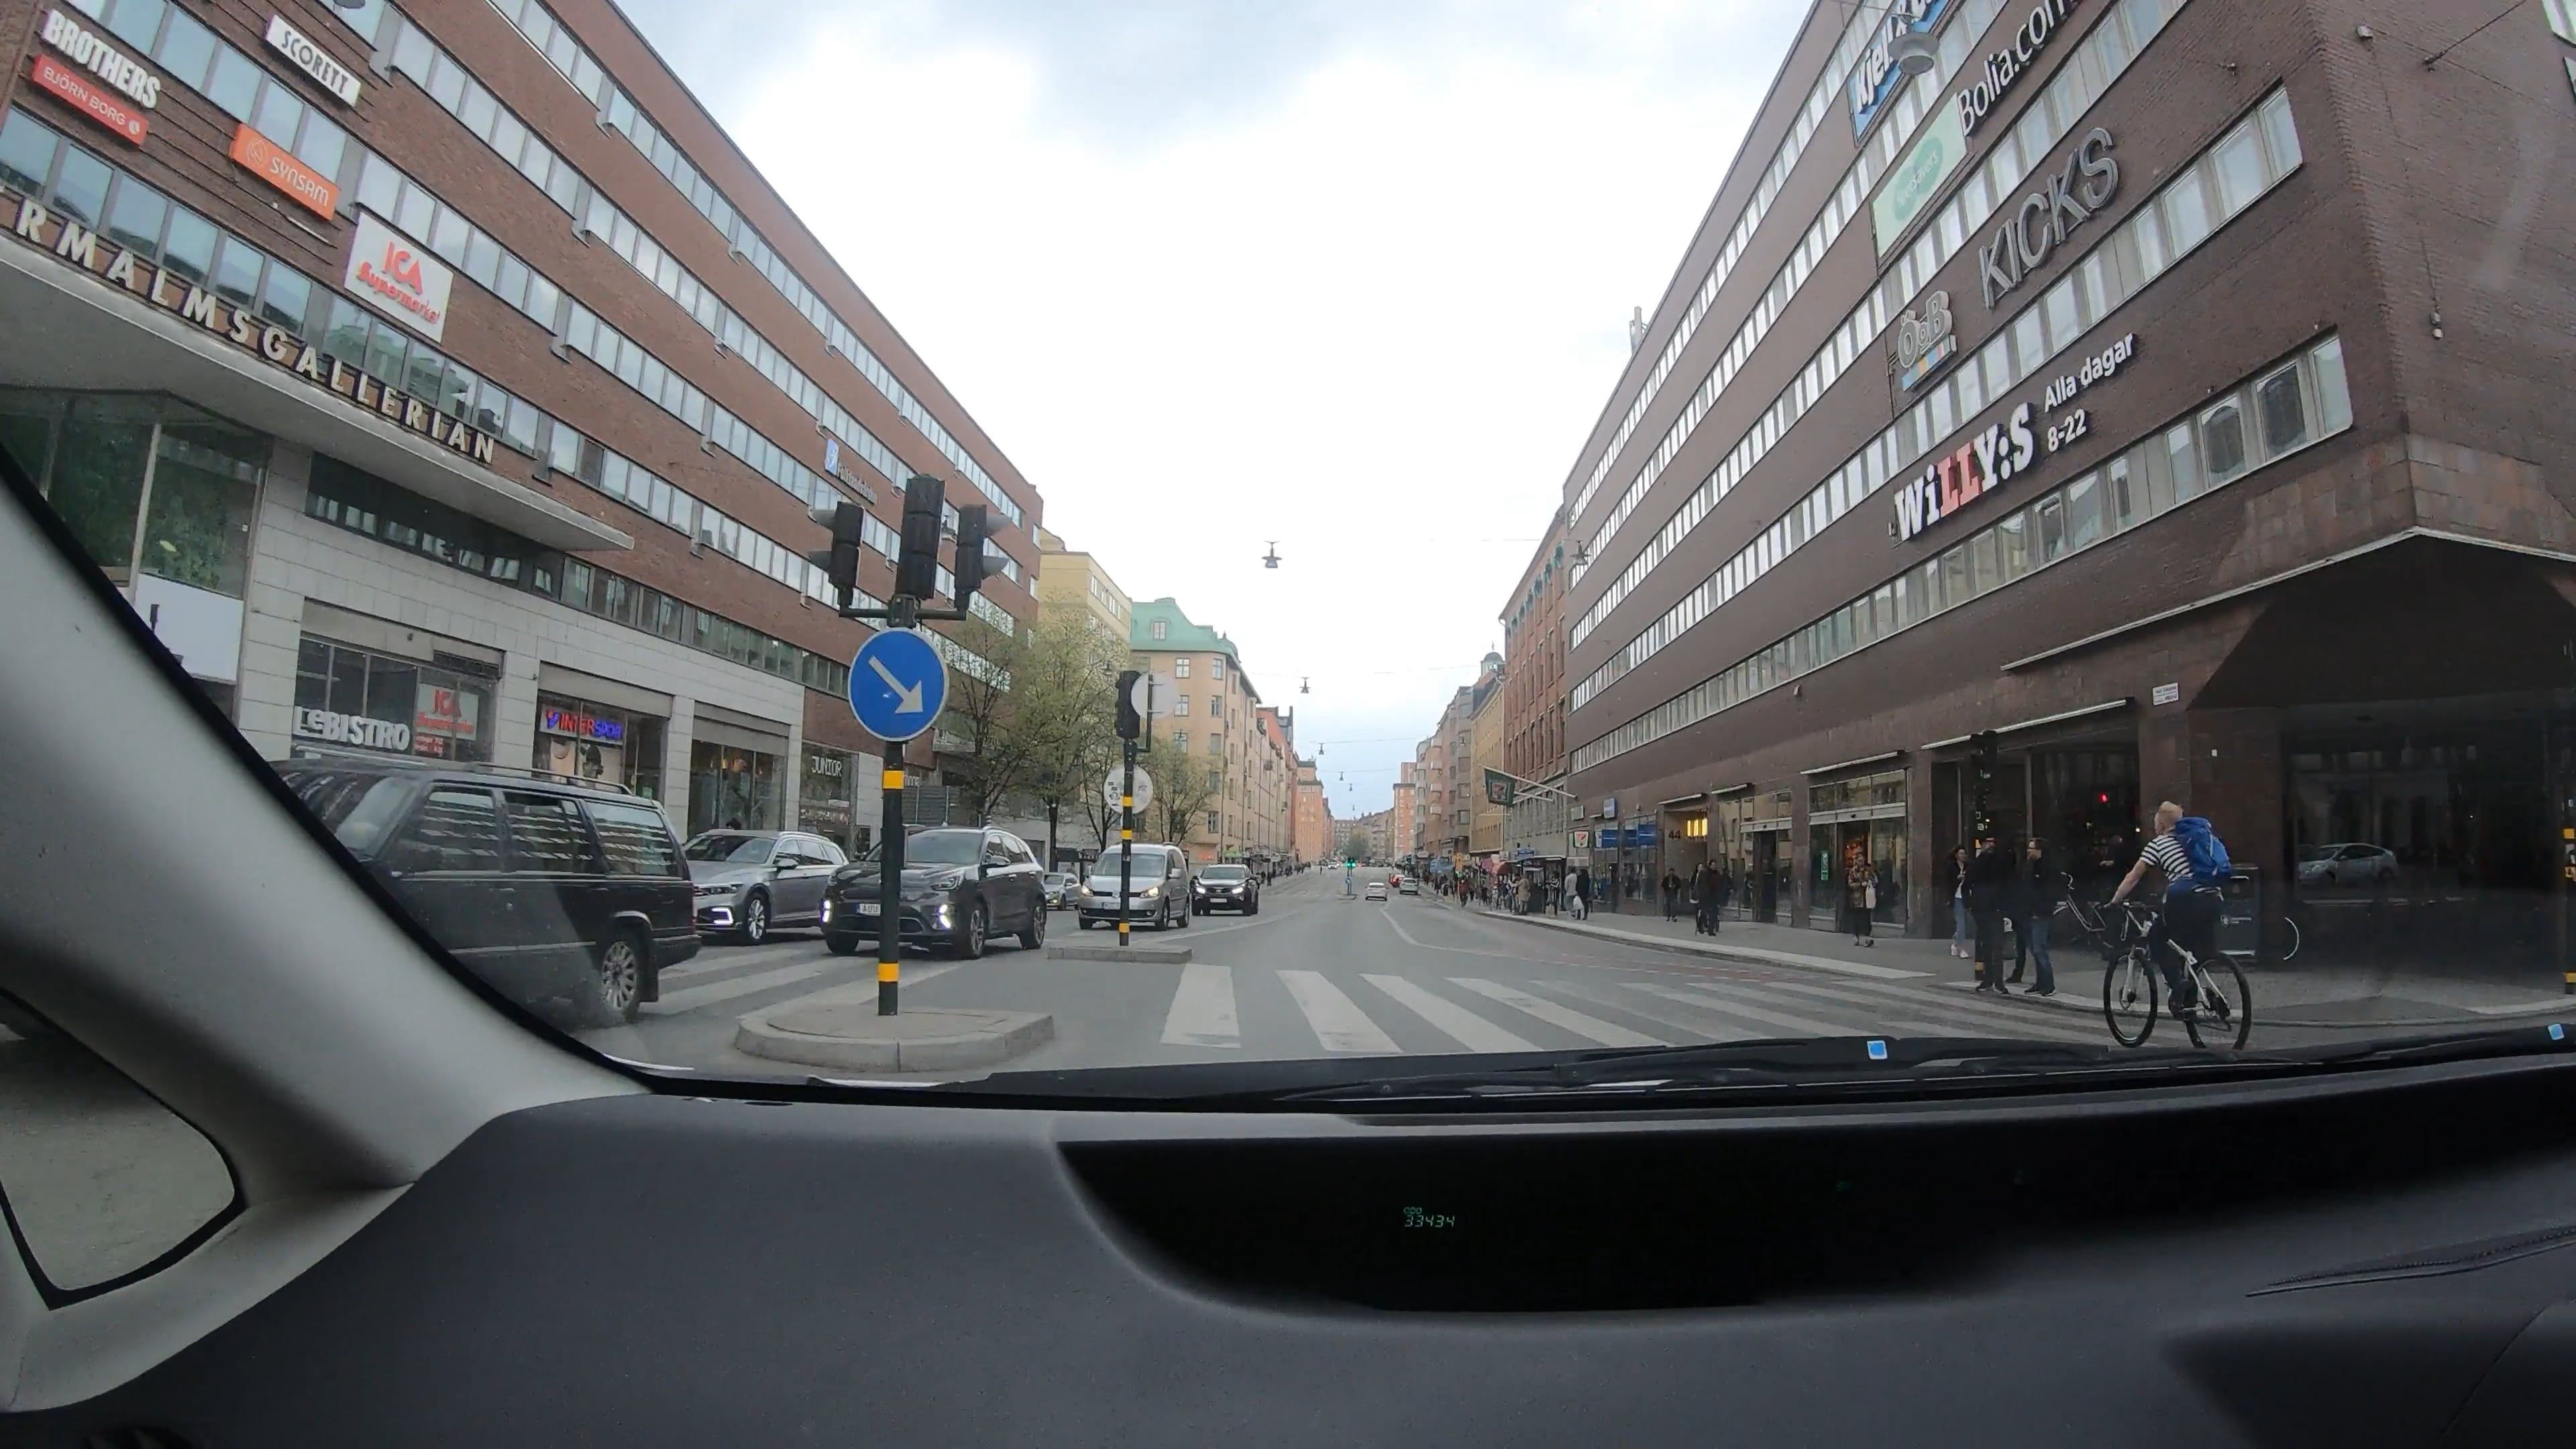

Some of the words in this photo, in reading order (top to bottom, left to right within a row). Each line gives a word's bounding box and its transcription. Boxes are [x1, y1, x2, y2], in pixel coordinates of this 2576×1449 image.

[43, 9, 161, 108] BROTHERS
[281, 30, 348, 94] SCORETT
[44, 66, 88, 101] BJÖRN
[89, 95, 126, 125] BORG
[1979, 127, 2118, 310] KICKS
[357, 261, 441, 325] Supermarket
[384, 241, 423, 295] ICA
[0, 185, 495, 465] RMALMSGALLERIAN
[2044, 375, 2077, 413] Alla
[2080, 333, 2135, 389] dagar
[2047, 408, 2088, 453] 8-22
[812, 755, 843, 777] JUNIOR
[1403, 1207, 1422, 1215] ODO
[1403, 1214, 1455, 1228] 33434
